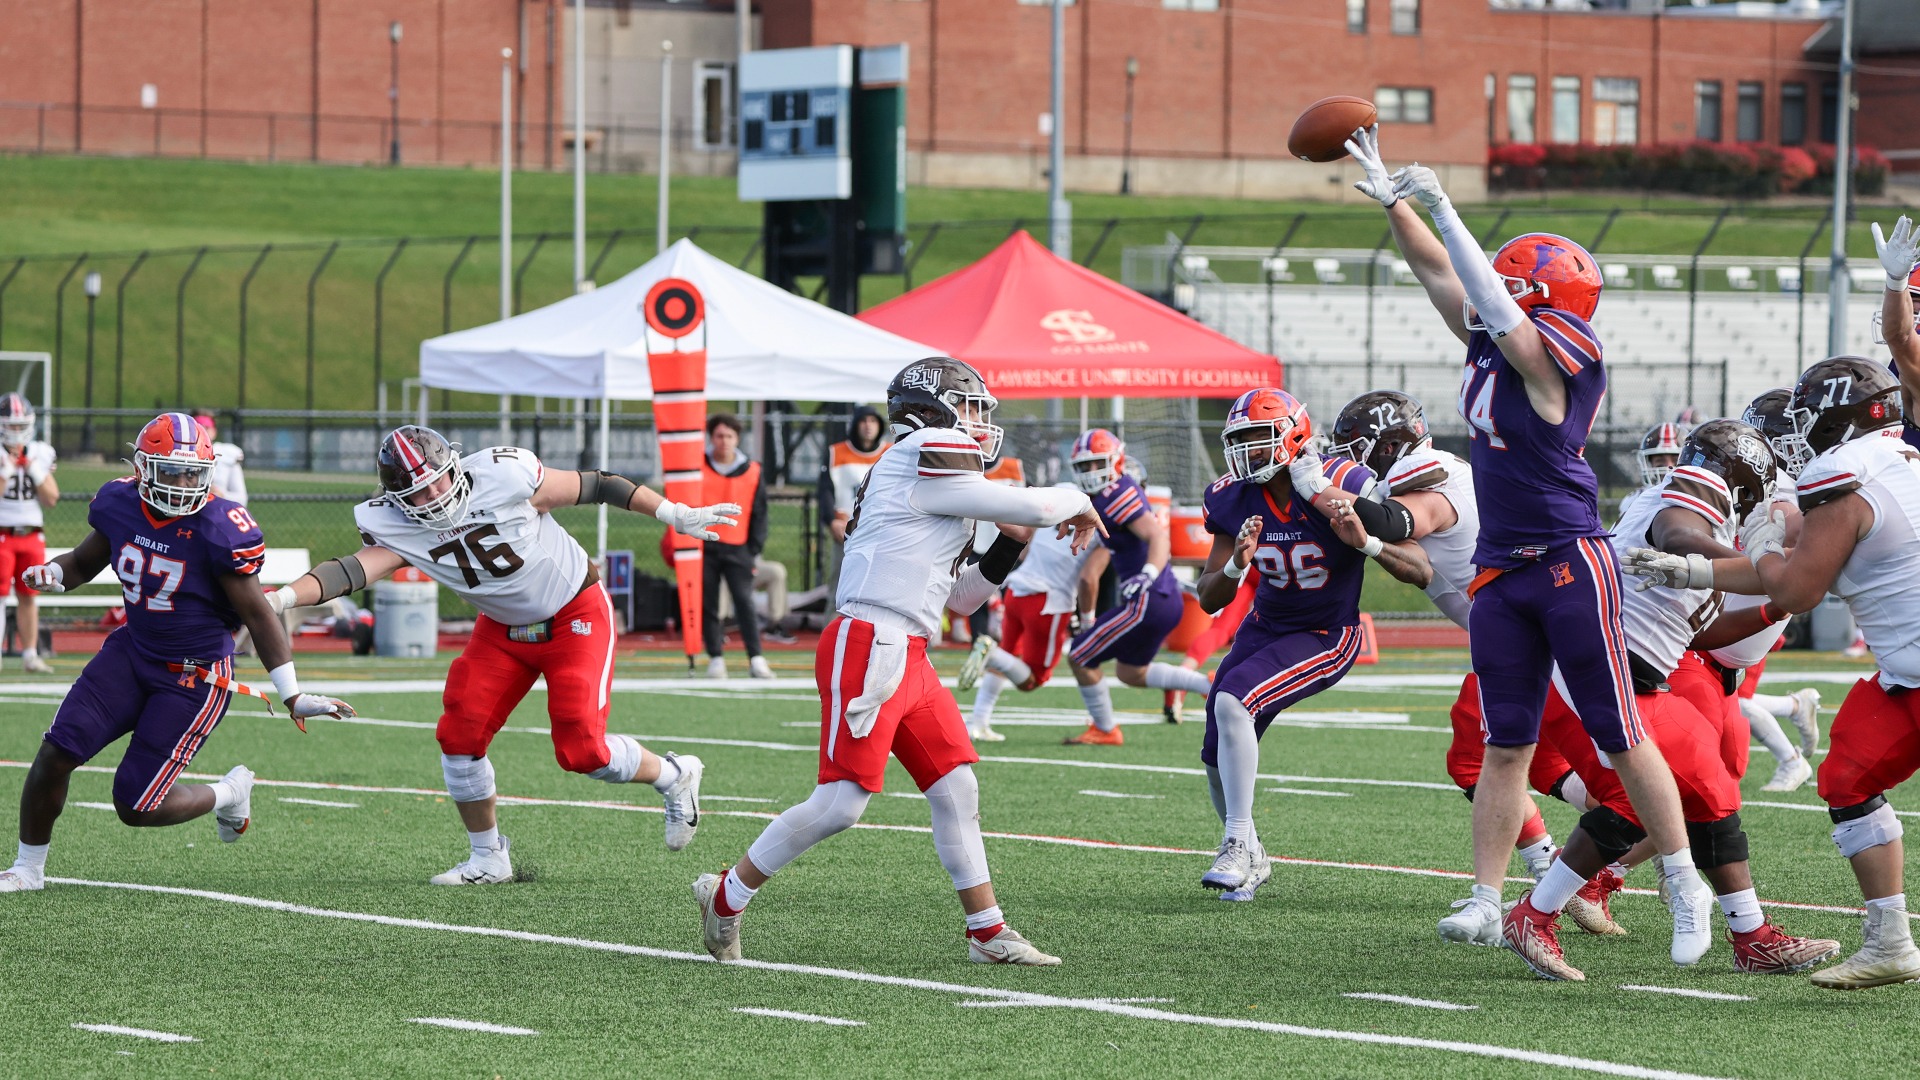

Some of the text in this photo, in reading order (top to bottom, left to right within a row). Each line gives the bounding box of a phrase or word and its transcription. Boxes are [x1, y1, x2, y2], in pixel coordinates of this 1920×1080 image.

[987, 368, 1269, 388] LAWRENCE UNIVERSITY FOOTBALL
[1823, 376, 1852, 408] 77
[1368, 402, 1401, 431] 72
[174, 451, 196, 459] Riddell
[226, 506, 259, 534] 97
[134, 534, 170, 554] HOBART
[1266, 532, 1302, 542] HOBART
[428, 523, 525, 590] 76
[1253, 541, 1332, 590] 96
[117, 542, 187, 612] 97
[1549, 561, 1575, 588] H
